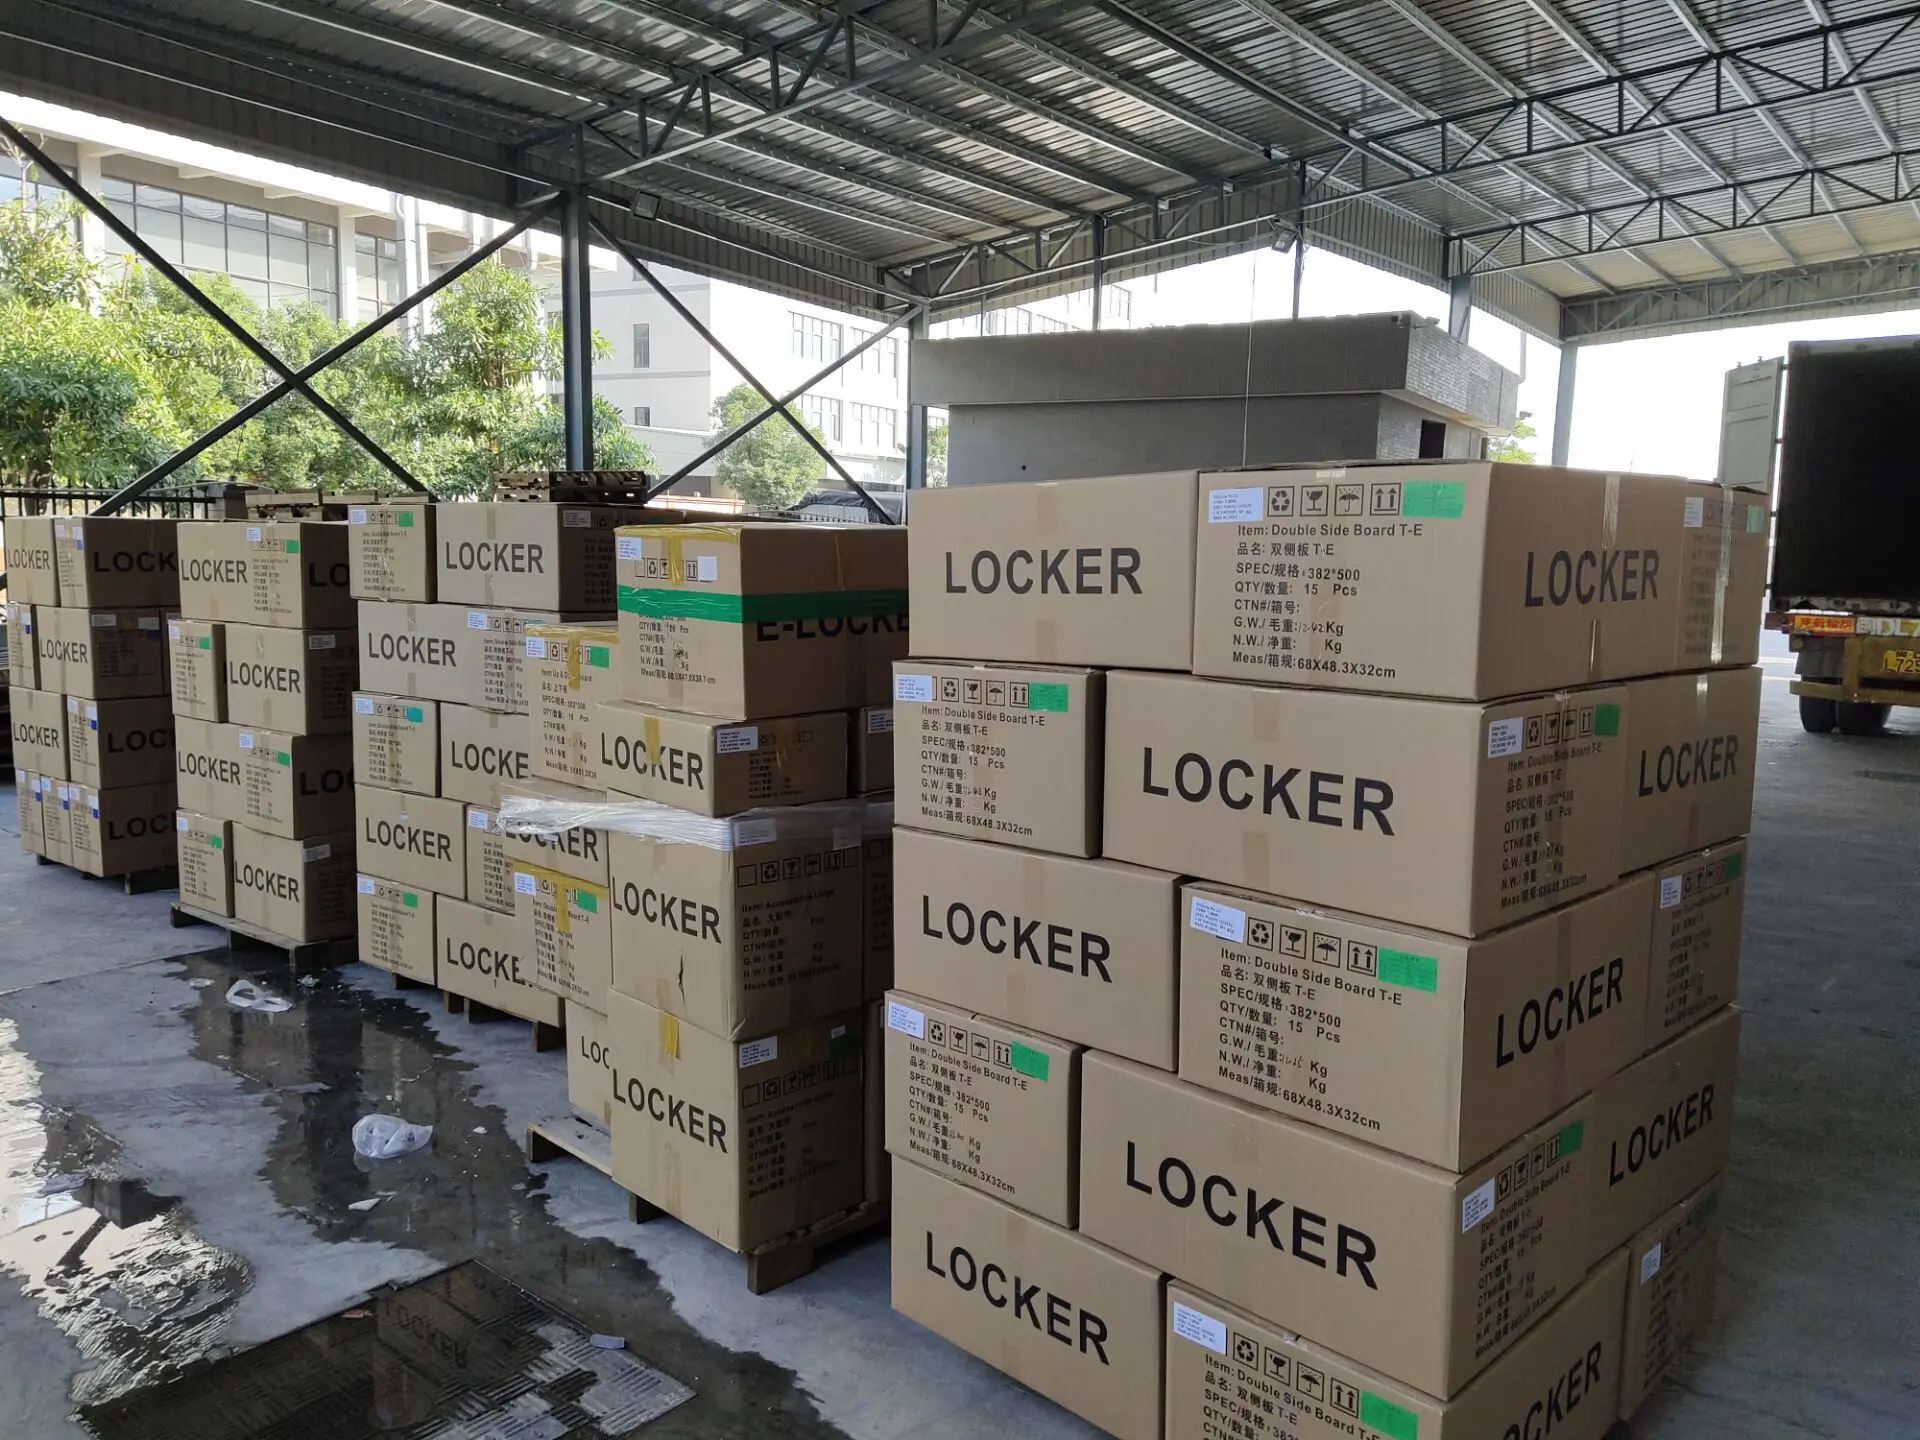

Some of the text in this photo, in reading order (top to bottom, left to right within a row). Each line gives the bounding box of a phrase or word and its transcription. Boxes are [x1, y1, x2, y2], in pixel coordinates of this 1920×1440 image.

[1238, 524, 1423, 536] Item: Double Side Board T-E
[8, 549, 50, 570] LOCKER
[446, 542, 544, 574] LOCKER
[1237, 542, 1334, 557] 品名: 双侧板 T-E
[181, 559, 248, 583] LOCKER
[946, 548, 1142, 594] LOCKER
[1525, 550, 1659, 607] LOCKER
[1304, 584, 1318, 595] 15
[1333, 584, 1357, 596] Pcs
[1325, 639, 1342, 654] Kg
[1326, 622, 1344, 636] Kg
[40, 639, 88, 664] LOCKER
[369, 632, 456, 667] LOCKER
[230, 661, 301, 694] LOCKER
[922, 705, 1045, 726] Item: Double Side Board T-E
[12, 723, 60, 748] LOCKER
[179, 752, 240, 785] LOCKER
[601, 732, 704, 790] LOCKER
[1639, 735, 1738, 797] LOCKER
[1143, 747, 1395, 836] LOCKER
[366, 817, 452, 862] LOCKER
[234, 861, 299, 903] LOCKER
[612, 876, 721, 944] LOCKER
[923, 895, 1112, 983] LOCKER
[1221, 947, 1403, 1006] Item: Double Side Board T-E
[1221, 964, 1315, 1001] 品名: 双侧板 T-E
[1496, 958, 1624, 1068] LOCKER
[1288, 1020, 1303, 1034] 15
[1317, 1026, 1340, 1044] Pcs
[1309, 1077, 1326, 1094] Kg
[1310, 1060, 1328, 1078] Kg
[613, 1068, 727, 1154] LOCKER
[1609, 1083, 1715, 1186] LOCKER
[1126, 1141, 1378, 1290] LOCKER
[926, 1230, 1110, 1367] LOCKER
[1205, 1354, 1234, 1376] Item:
[1238, 1369, 1281, 1399] Double
[1284, 1389, 1311, 1414] Side
[1315, 1407, 1354, 1435] Board
